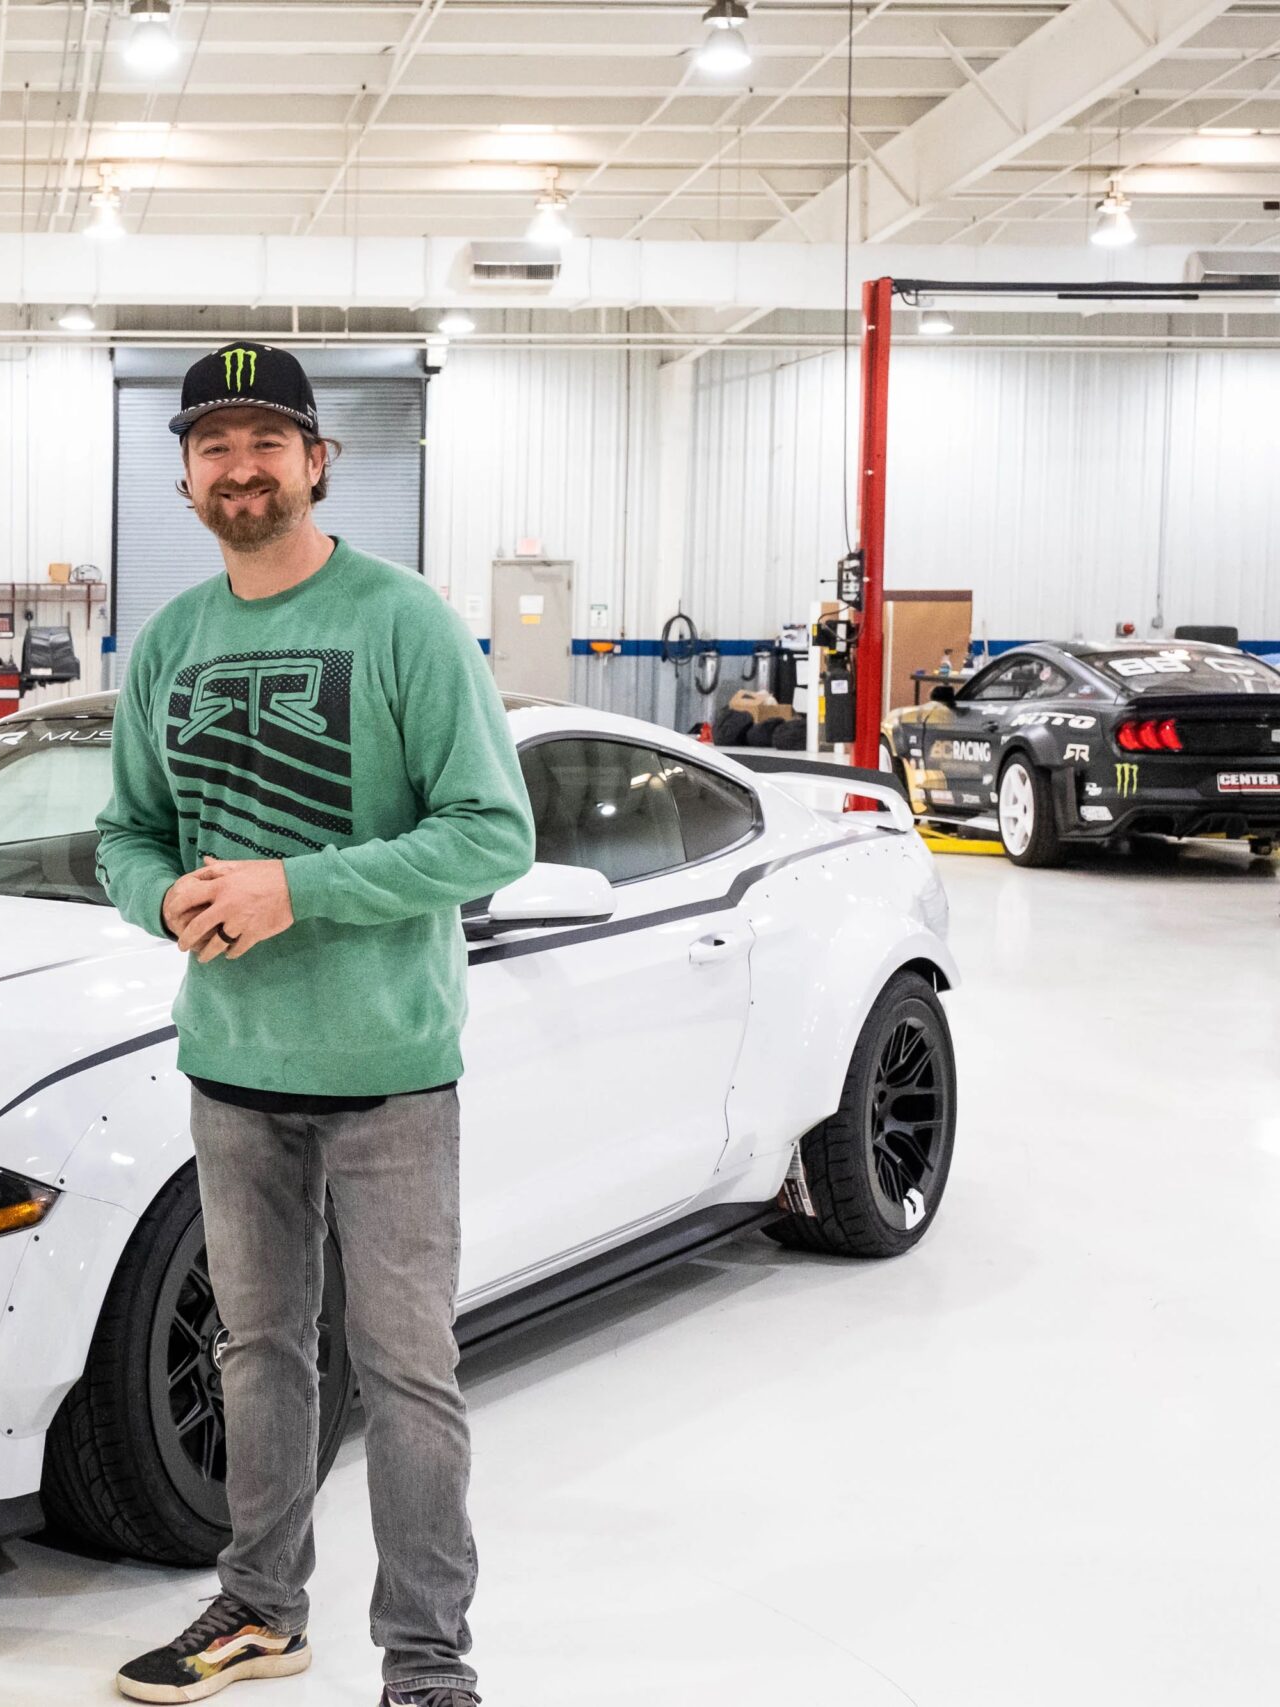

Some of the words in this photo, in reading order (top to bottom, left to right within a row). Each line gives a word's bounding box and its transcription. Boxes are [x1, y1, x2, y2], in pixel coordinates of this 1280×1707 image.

[177, 658, 328, 746] RTR
[953, 740, 992, 762] RACING
[1219, 773, 1279, 786] CENTER
